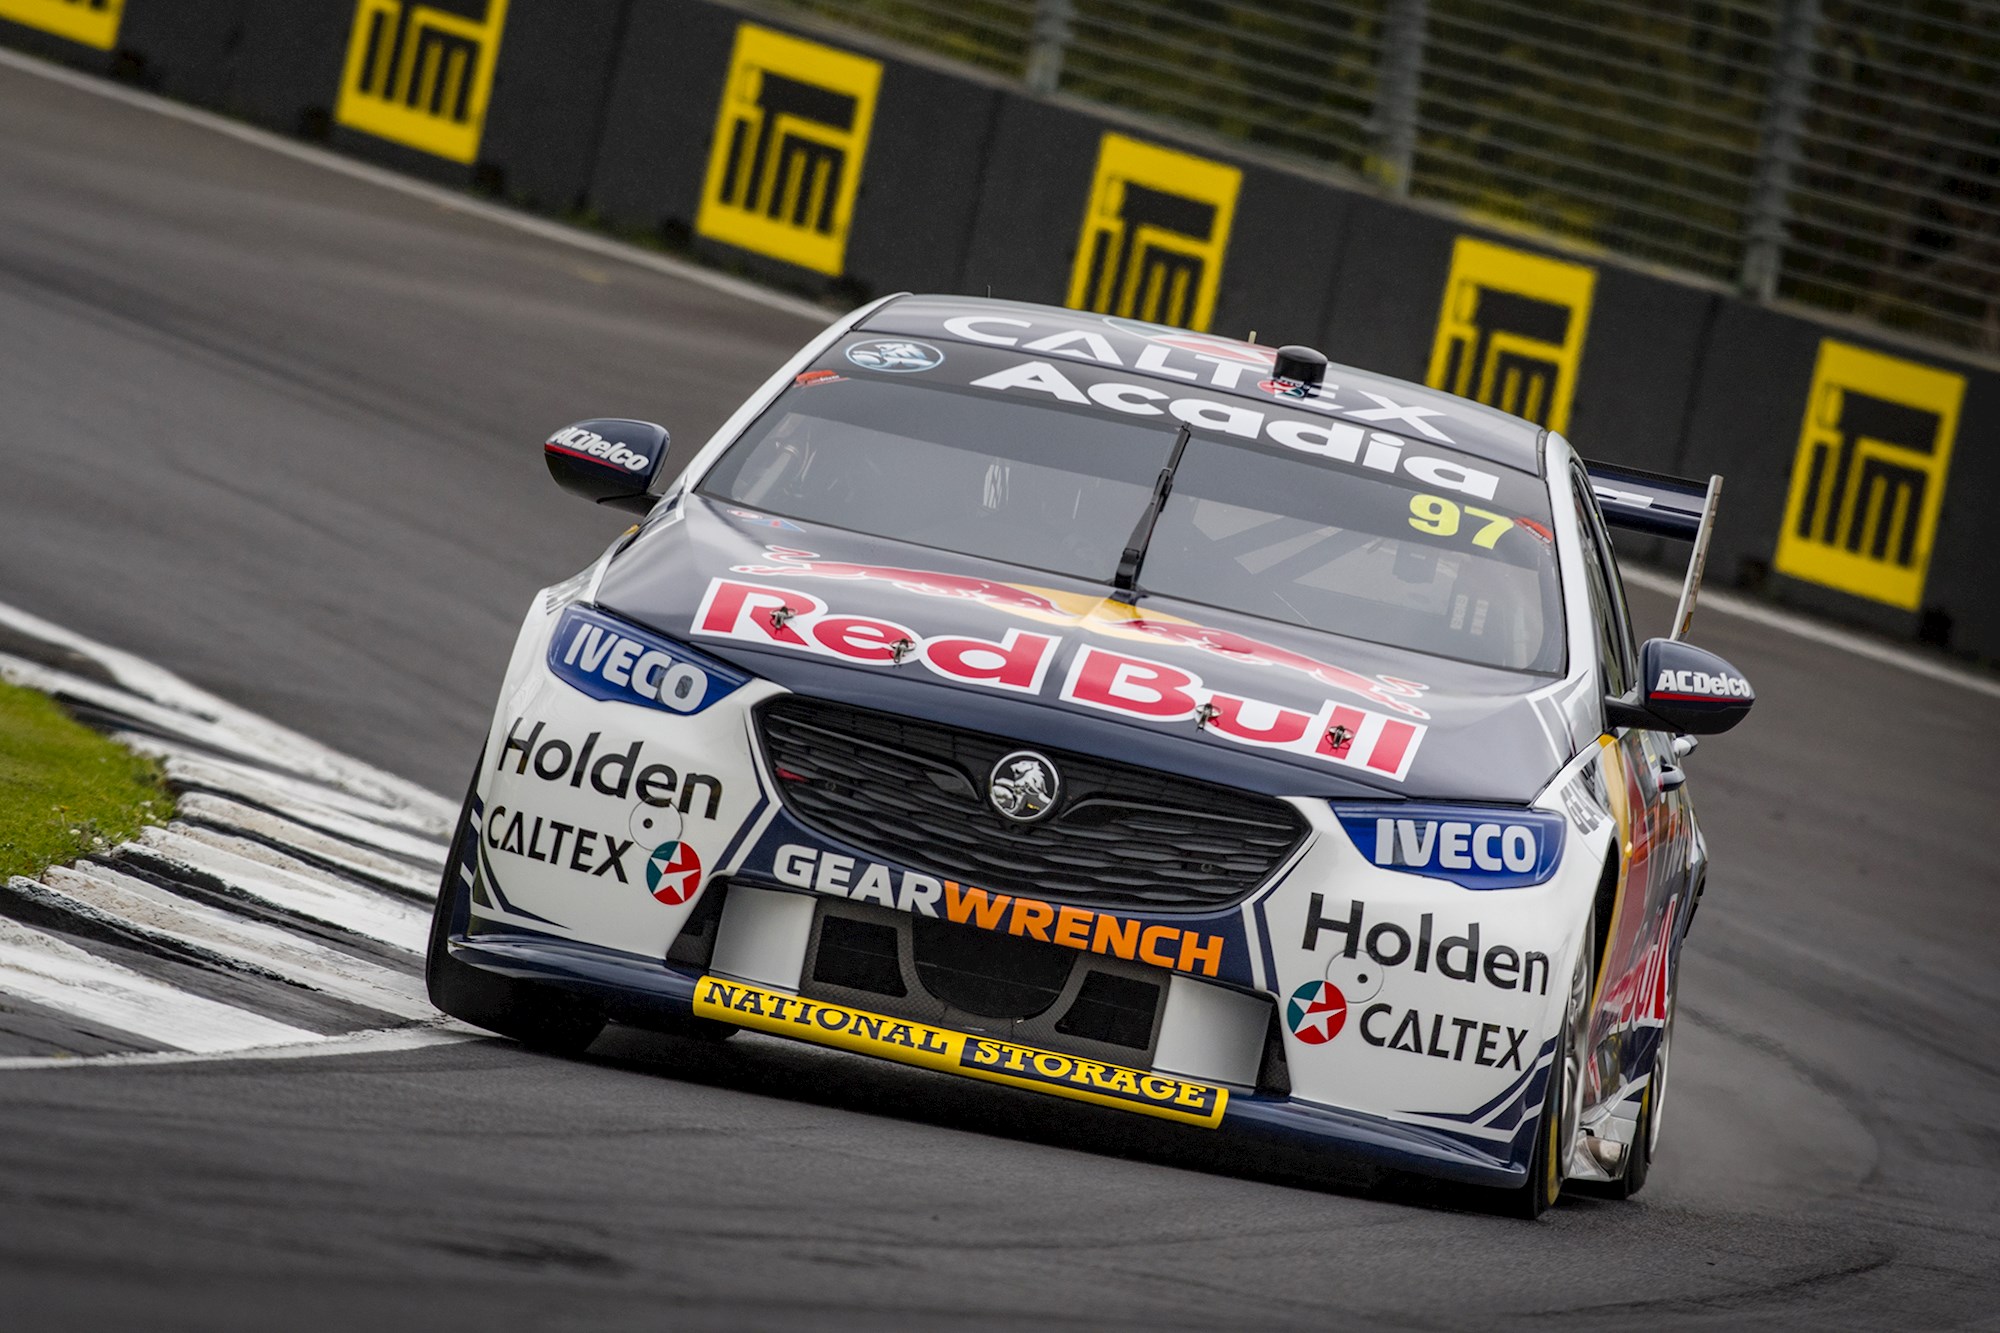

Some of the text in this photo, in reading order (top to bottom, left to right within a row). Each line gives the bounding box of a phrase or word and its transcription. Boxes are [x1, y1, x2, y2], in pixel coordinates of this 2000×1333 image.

[550, 426, 650, 471] ACDelco
[970, 361, 1500, 500] Acadia
[1408, 494, 1514, 550] 97
[563, 622, 710, 712] IVECO
[690, 577, 1428, 782] Red Bull
[1655, 669, 1751, 697] ACDelco
[497, 716, 722, 820] Holden
[487, 805, 634, 885] CALTEX
[1375, 818, 1537, 873] IVECO
[1302, 892, 1550, 997] Holden
[703, 976, 1208, 1108] NATIONAL STORAGE
[1359, 1002, 1529, 1072] CALTEX
